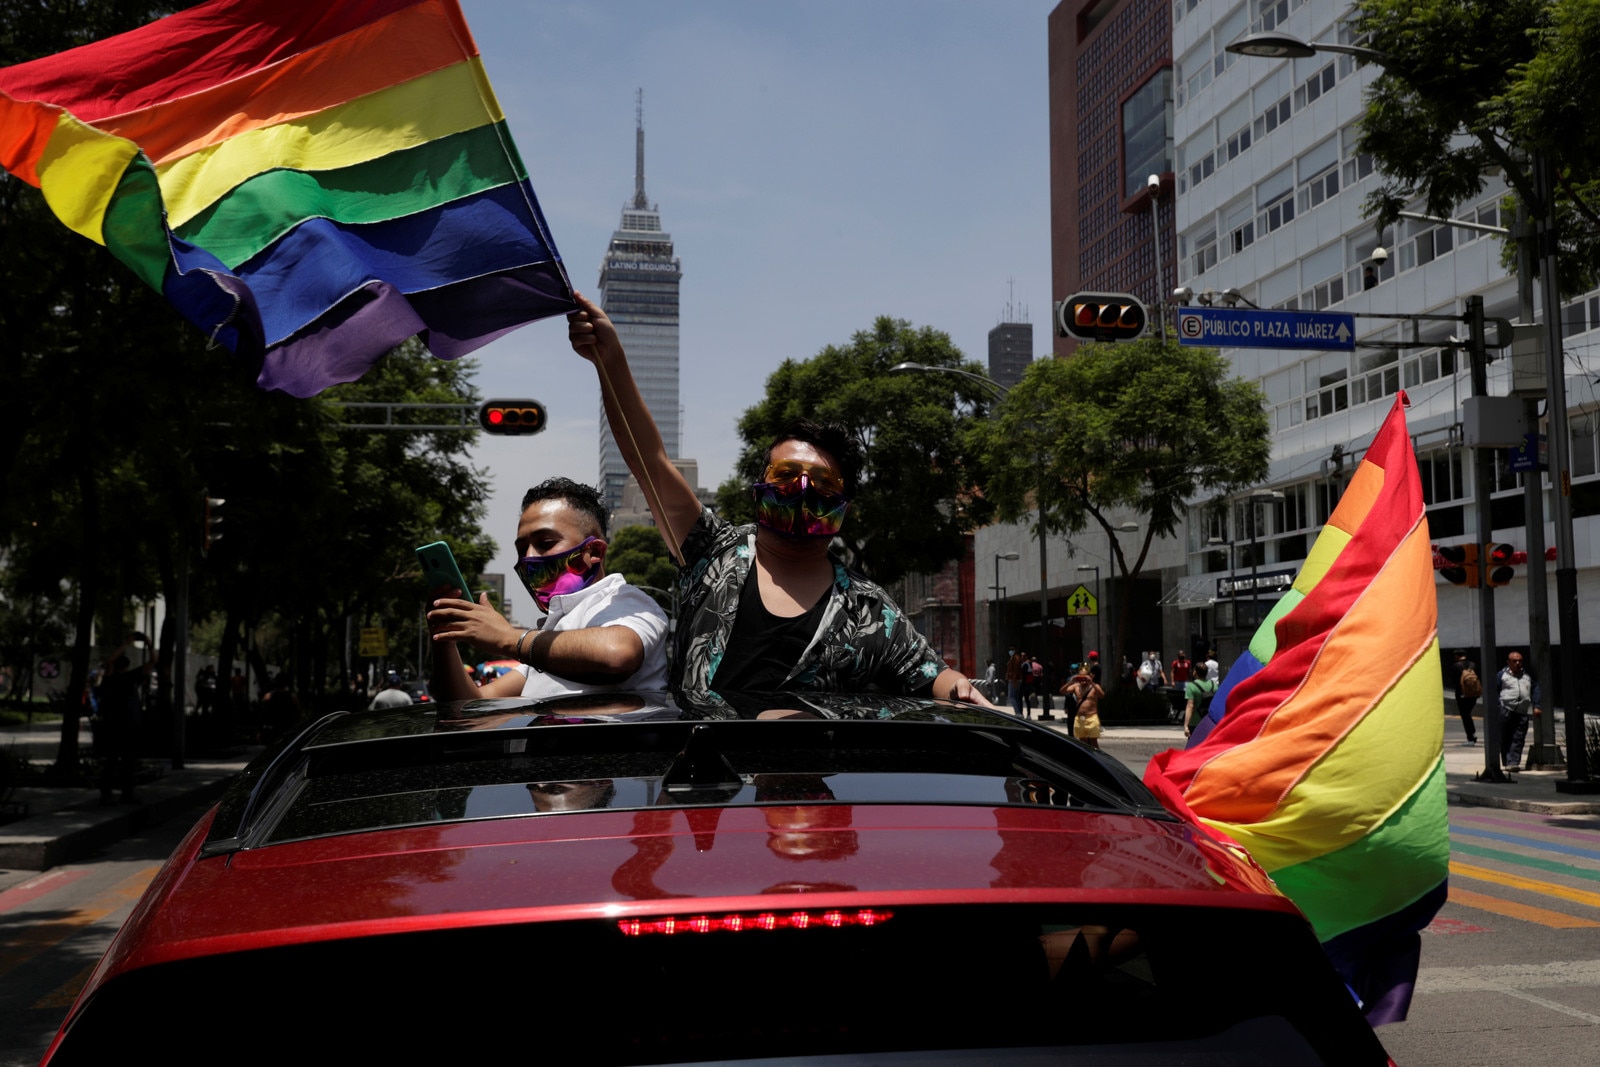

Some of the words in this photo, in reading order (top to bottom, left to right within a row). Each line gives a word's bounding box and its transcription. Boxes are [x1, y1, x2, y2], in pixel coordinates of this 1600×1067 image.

[609, 261, 638, 270] LATINO
[638, 262, 677, 272] SEGUROS
[1203, 314, 1251, 337] PÚBLICO
[1253, 320, 1292, 338] PLAZA
[1294, 317, 1335, 340] JUÁREZ
